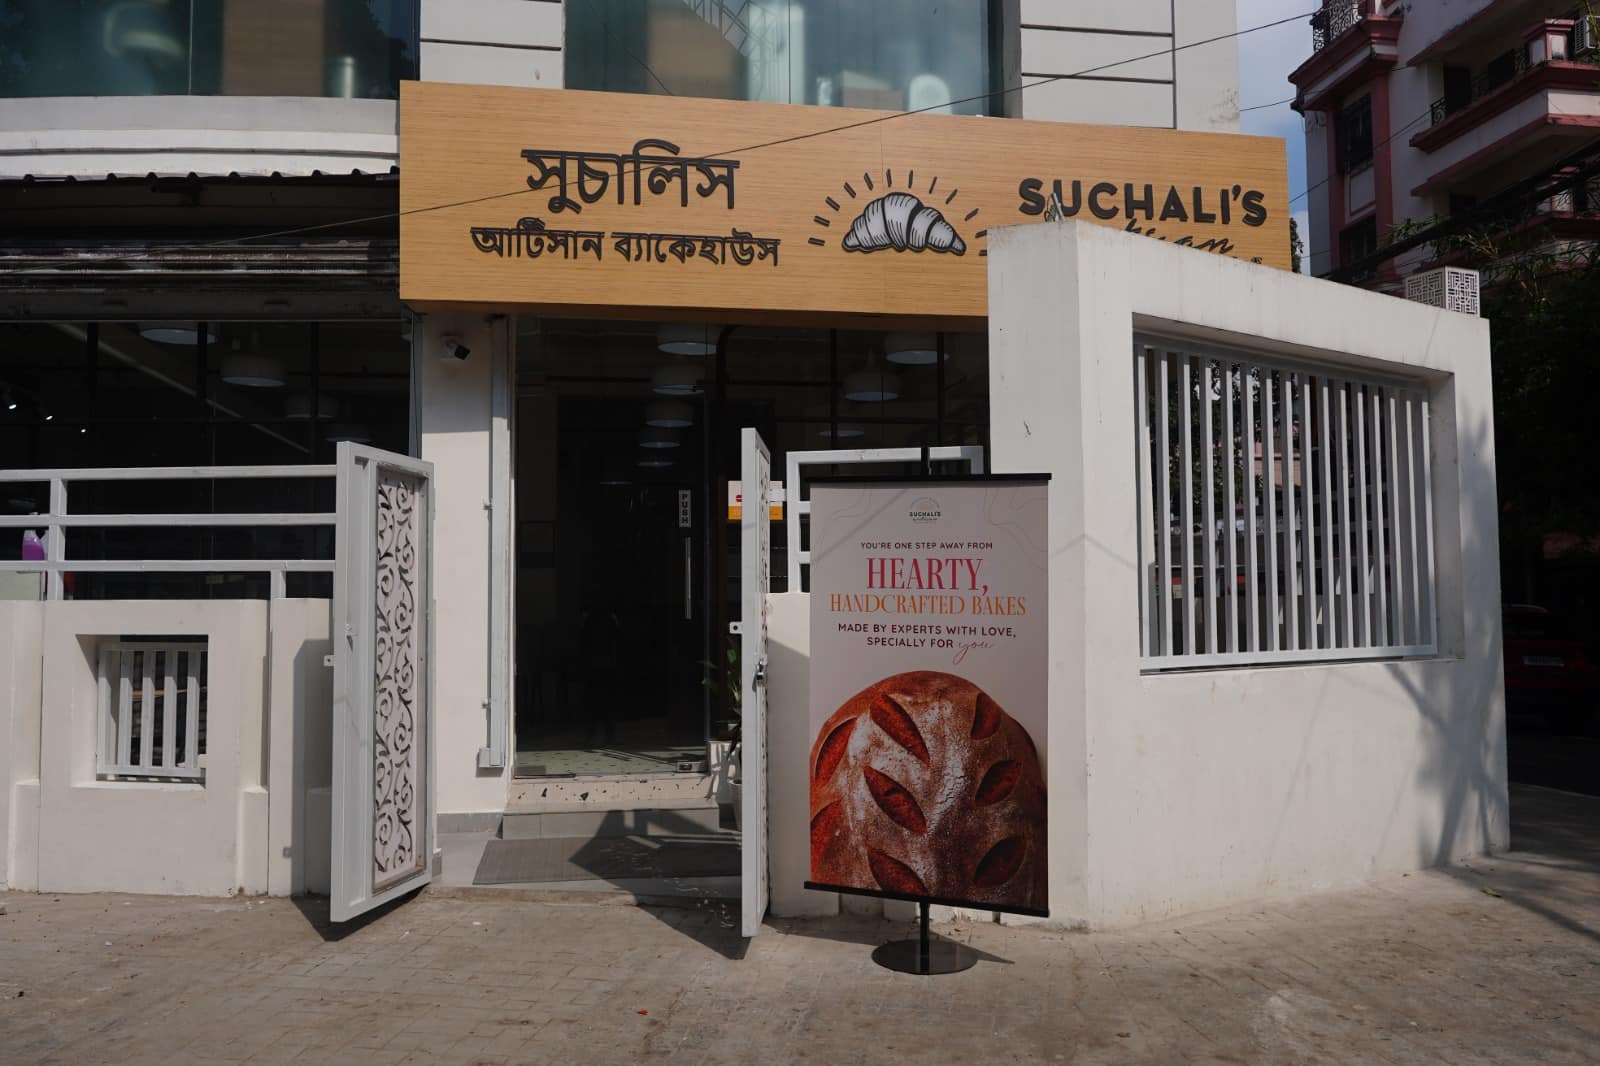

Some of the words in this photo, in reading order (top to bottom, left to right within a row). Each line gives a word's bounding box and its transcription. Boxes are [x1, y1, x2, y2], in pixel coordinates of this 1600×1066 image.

[520, 138, 740, 214] সুচালিস
[1018, 177, 1267, 227] SUCHALI'S
[611, 228, 782, 267] ব্যাকেহাউস
[681, 493, 689, 523] PUSH
[860, 541, 892, 550] YOU'RE
[895, 541, 913, 550] ONE
[915, 541, 937, 550] STEP
[939, 541, 965, 550] AWAY
[967, 541, 993, 550] FROM
[866, 557, 989, 595] HEARTY,
[831, 593, 966, 615] HANDCRAFTED
[972, 595, 1027, 616] BAKES
[838, 623, 869, 633] MADE
[873, 624, 887, 634] BY
[891, 624, 942, 635] EXPERTS
[945, 625, 977, 636] WITH
[981, 626, 1017, 638] LOVE,
[867, 637, 926, 648] SPECIALLY
[930, 638, 954, 649] FOR
[952, 642, 994, 665] you
